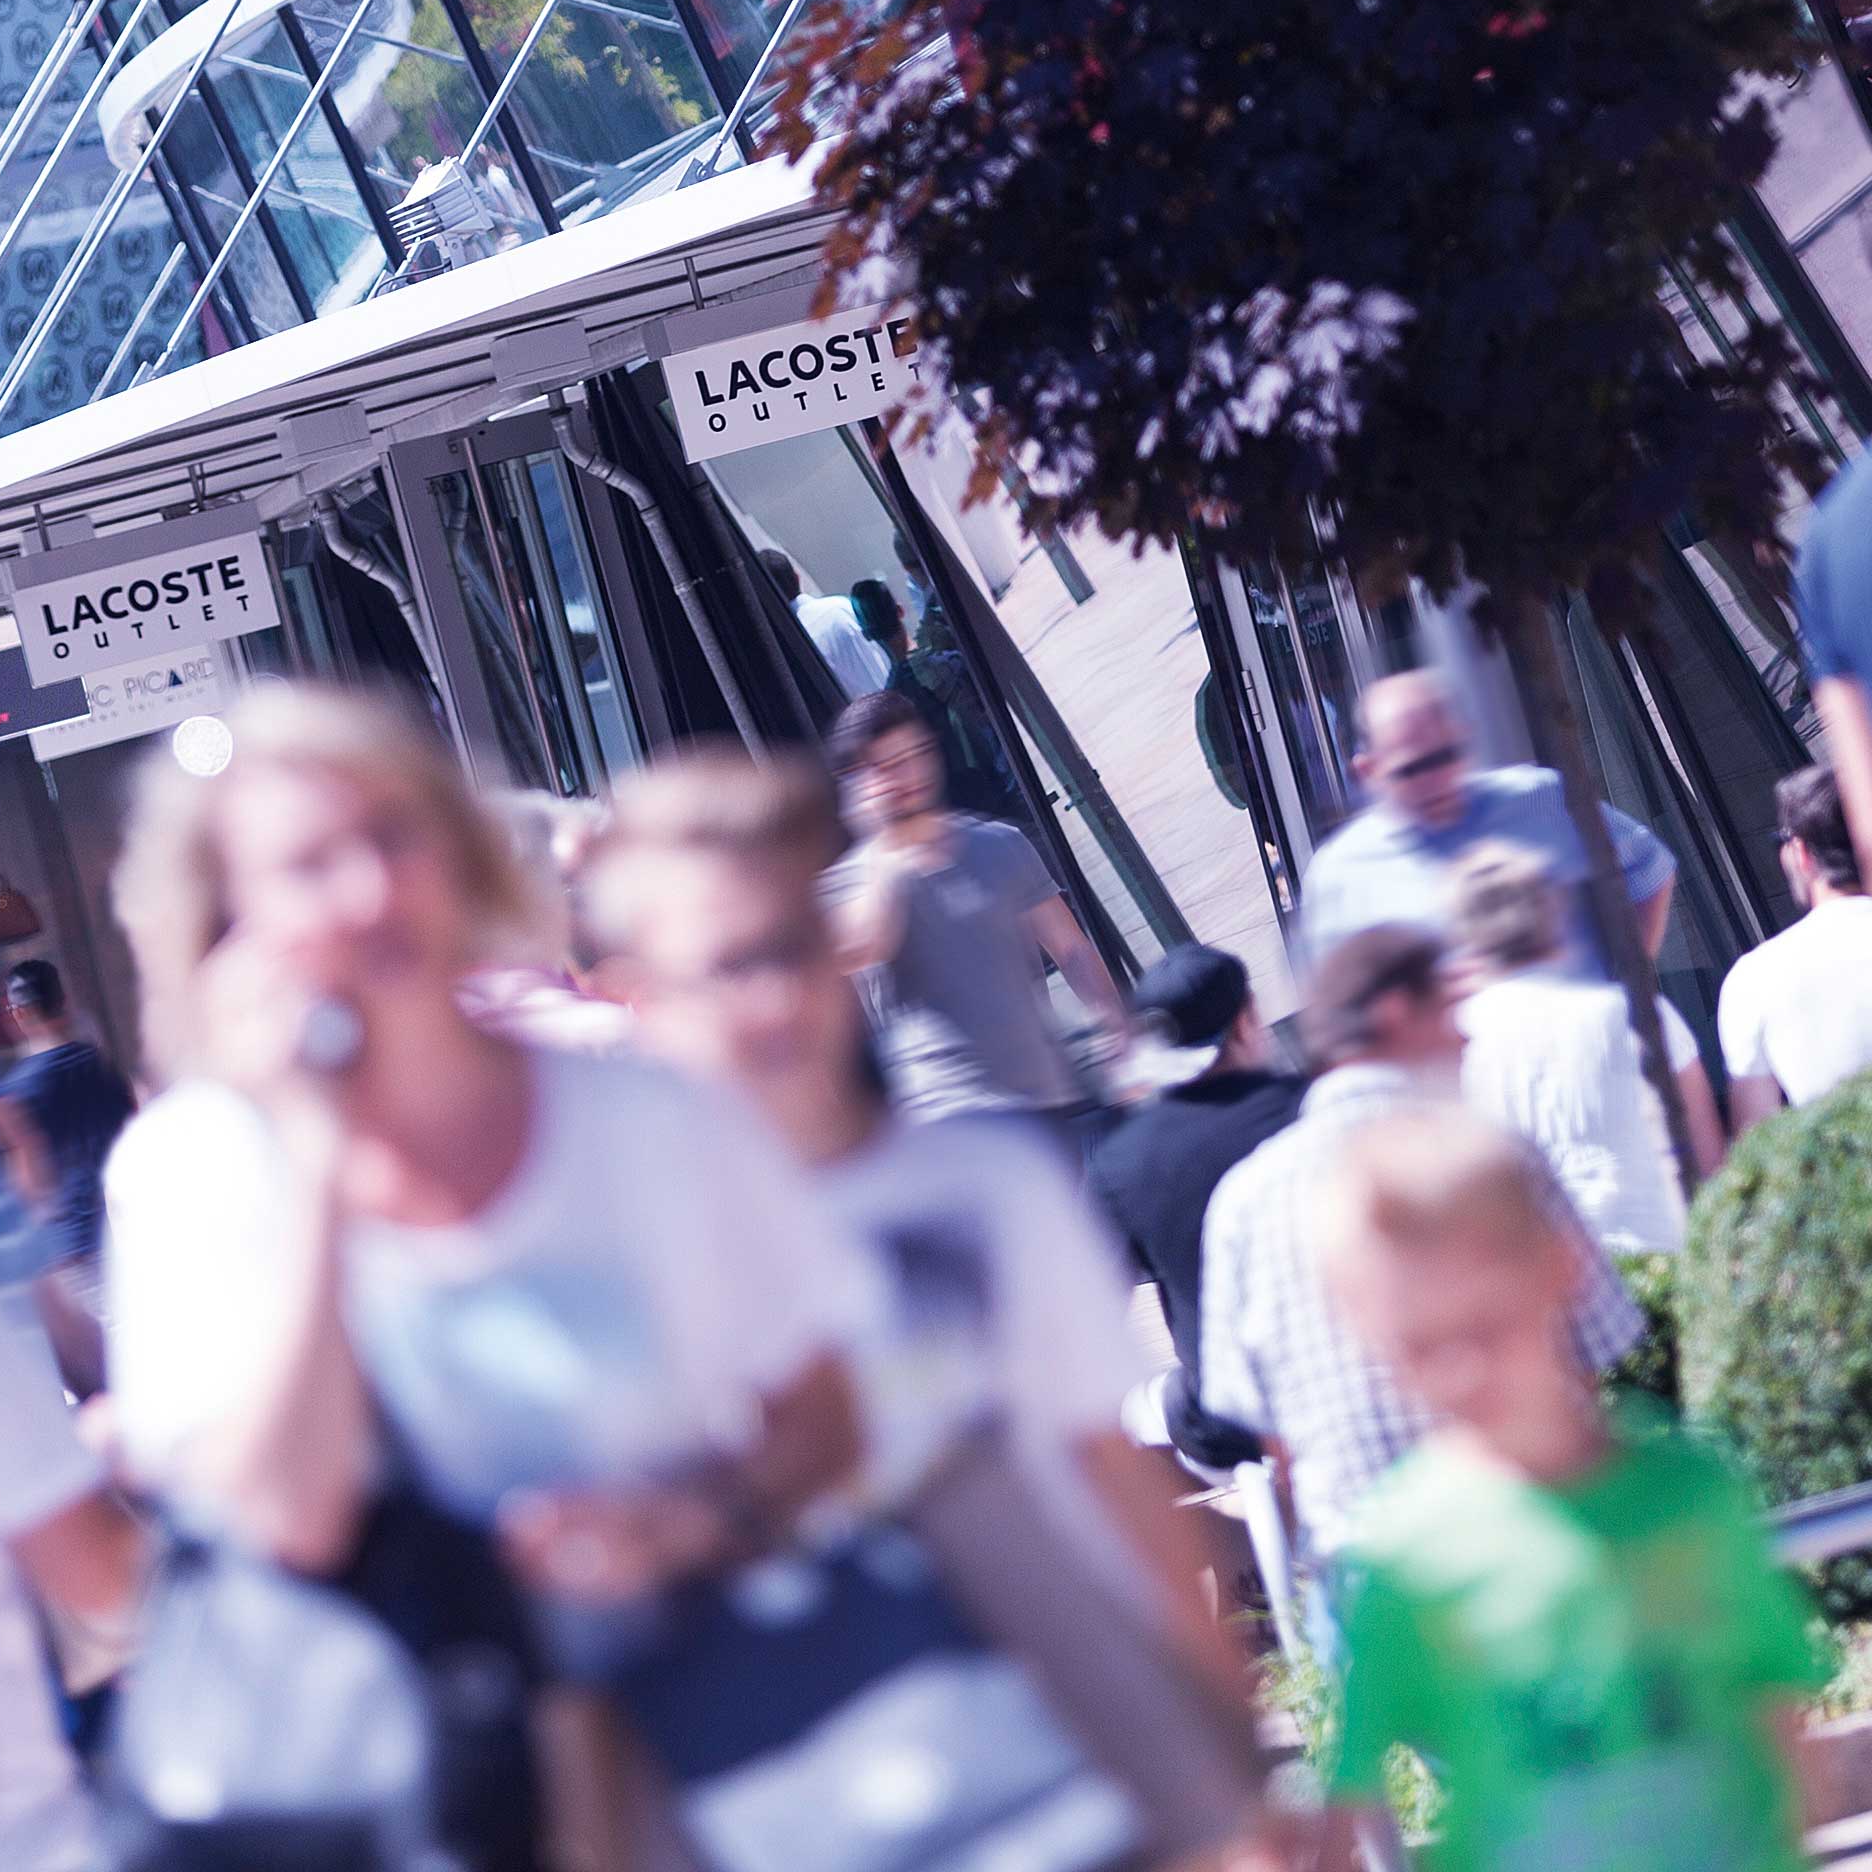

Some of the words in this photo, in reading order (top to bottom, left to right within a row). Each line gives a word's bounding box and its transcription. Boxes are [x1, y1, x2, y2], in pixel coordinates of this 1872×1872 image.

[694, 317, 918, 407] LACOSTE
[708, 361, 923, 433] OUTLET
[41, 555, 246, 636] LACOSTE
[52, 593, 250, 659] OUTLET
